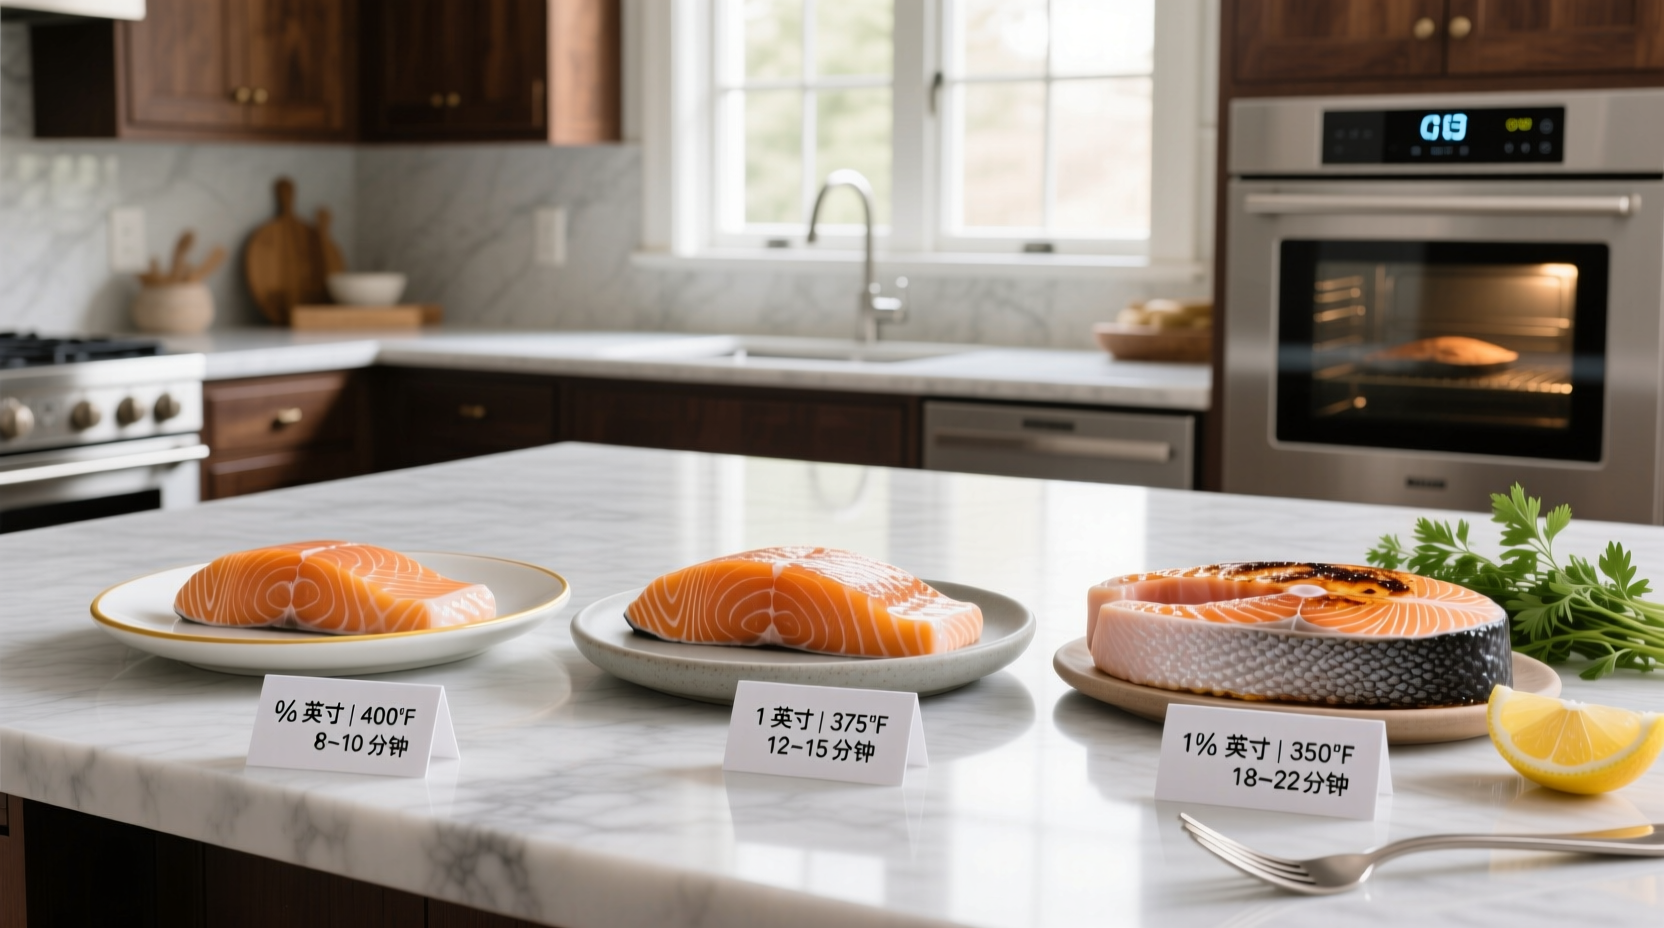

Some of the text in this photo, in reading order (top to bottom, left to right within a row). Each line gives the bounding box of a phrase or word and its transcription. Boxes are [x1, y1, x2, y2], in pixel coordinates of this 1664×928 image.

[301, 700, 345, 725] 英寸
[756, 707, 765, 726] 1
[770, 705, 815, 731] 英寸
[367, 734, 409, 758] 分钟
[1224, 733, 1271, 761] 英寸
